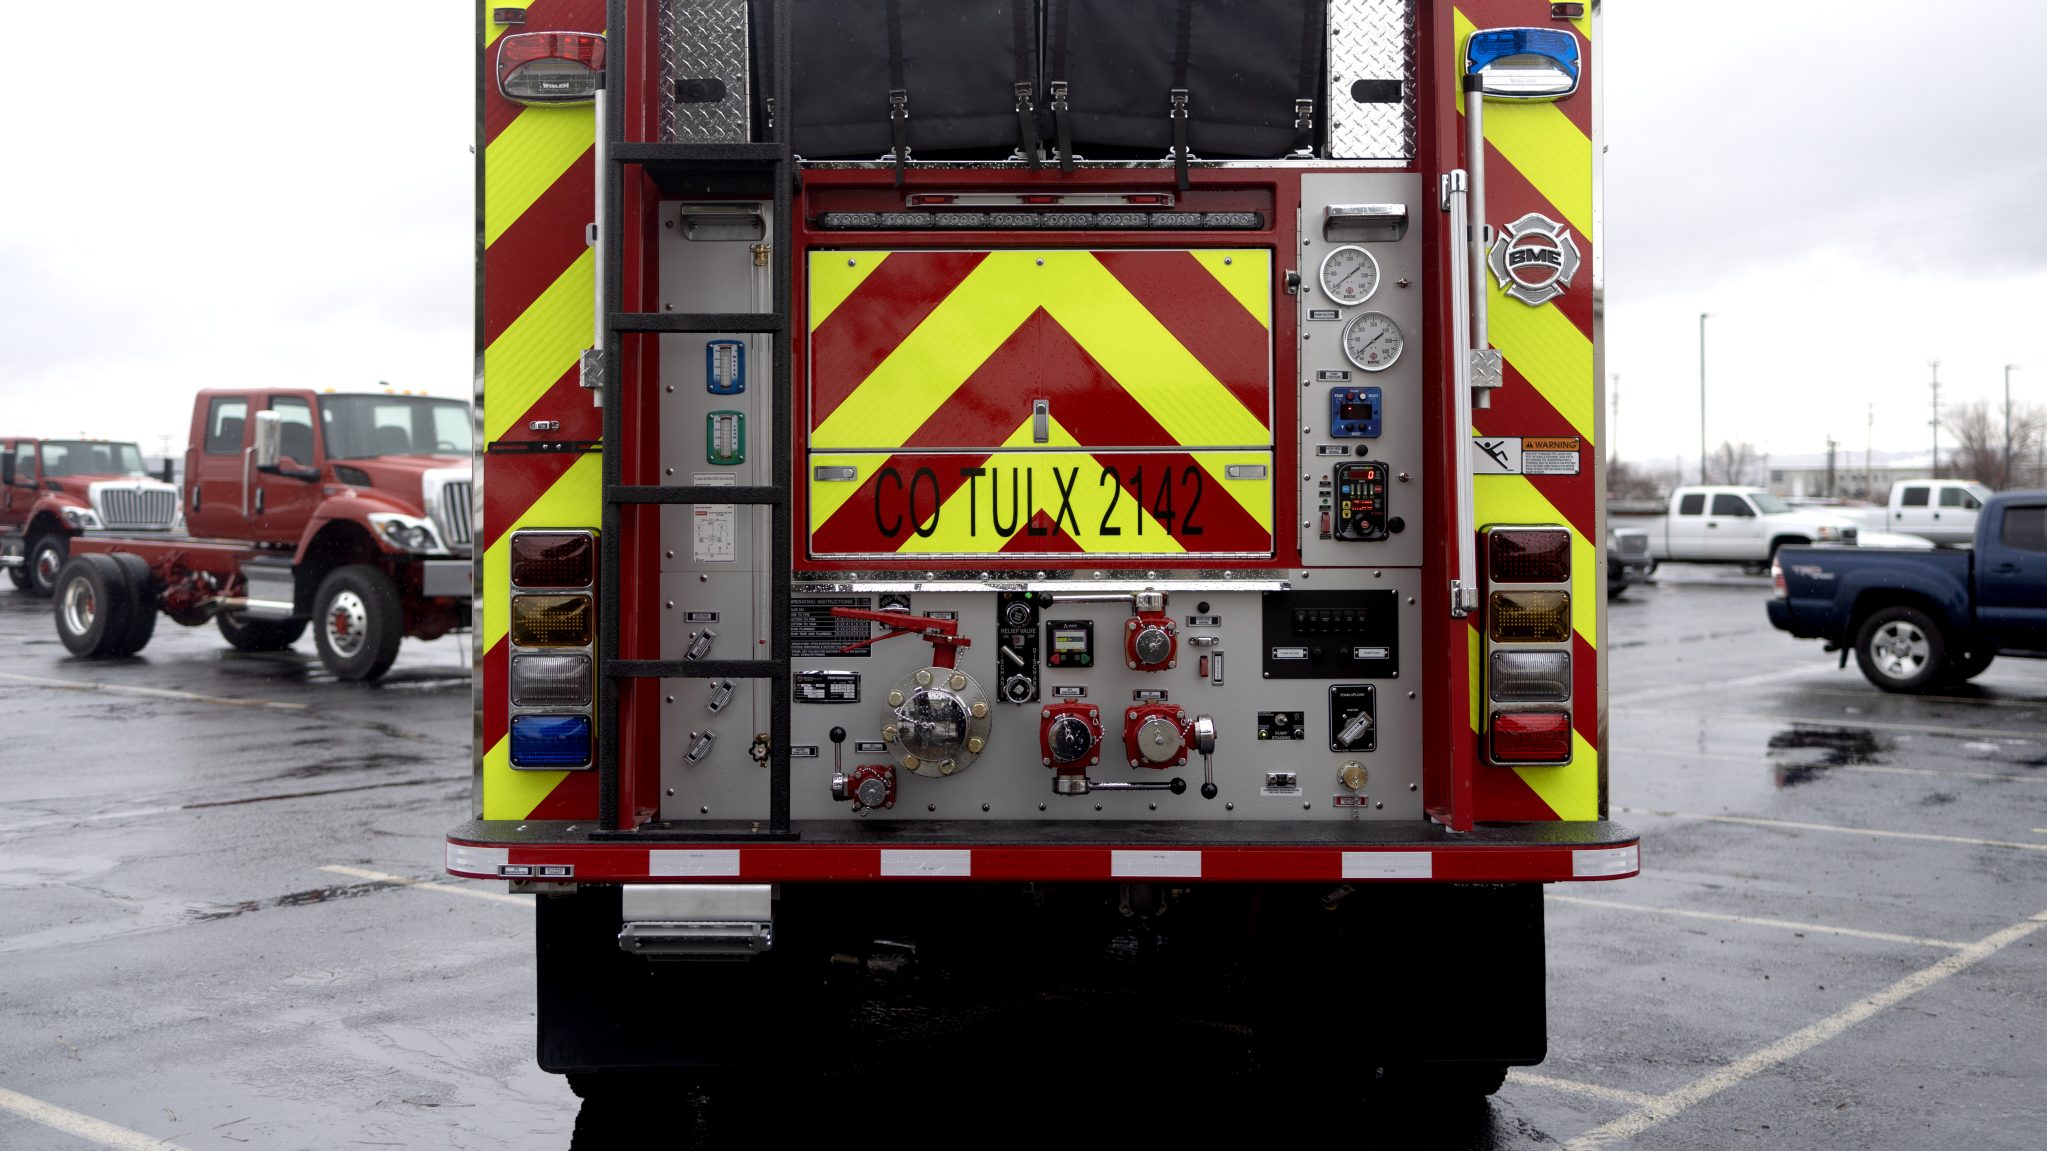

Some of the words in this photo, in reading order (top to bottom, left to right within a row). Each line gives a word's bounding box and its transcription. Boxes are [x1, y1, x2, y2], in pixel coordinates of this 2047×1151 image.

[1508, 247, 1562, 268] BME
[1535, 440, 1577, 449] WARNING
[1367, 470, 1375, 480] 0
[874, 466, 940, 538] CO
[960, 466, 1080, 538] TULX
[1099, 466, 1204, 537] 2142
